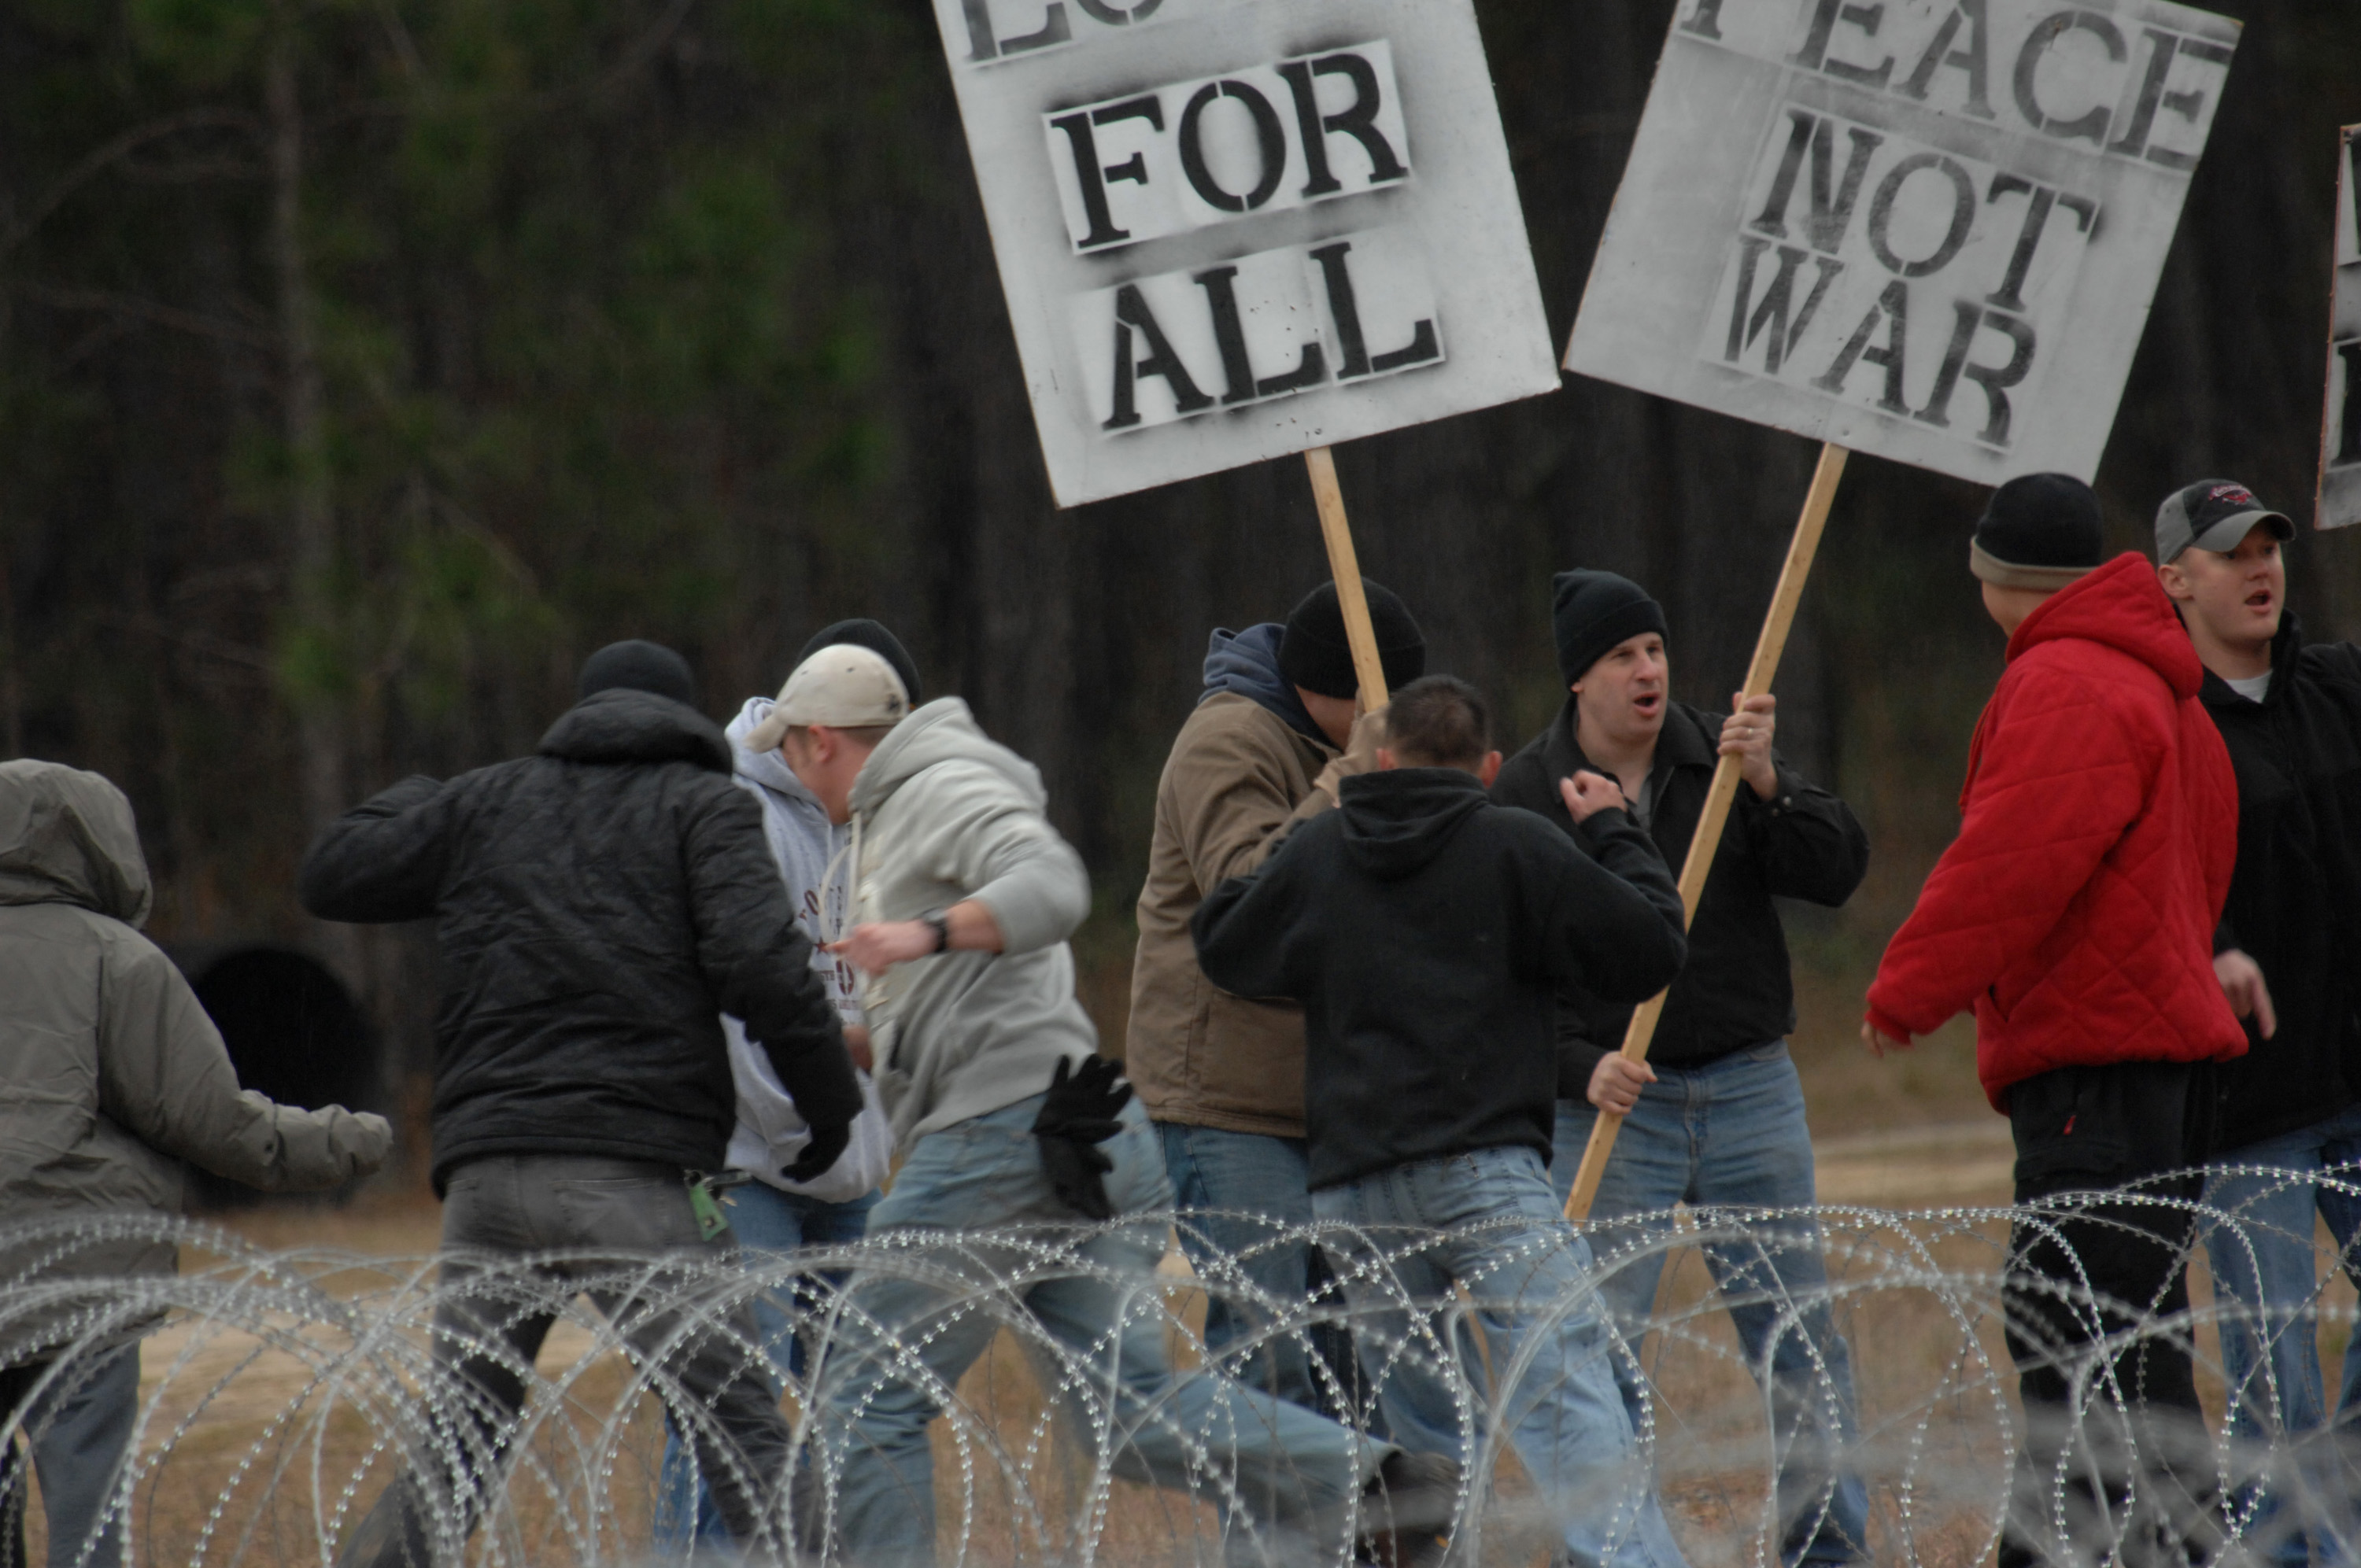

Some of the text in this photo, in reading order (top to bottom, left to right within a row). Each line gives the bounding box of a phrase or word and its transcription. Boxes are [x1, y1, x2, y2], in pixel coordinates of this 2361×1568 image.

[1051, 53, 1409, 249] FOR
[1749, 109, 2099, 312] NOT
[1103, 242, 1440, 430] ALL
[1725, 239, 2037, 447] WAR
